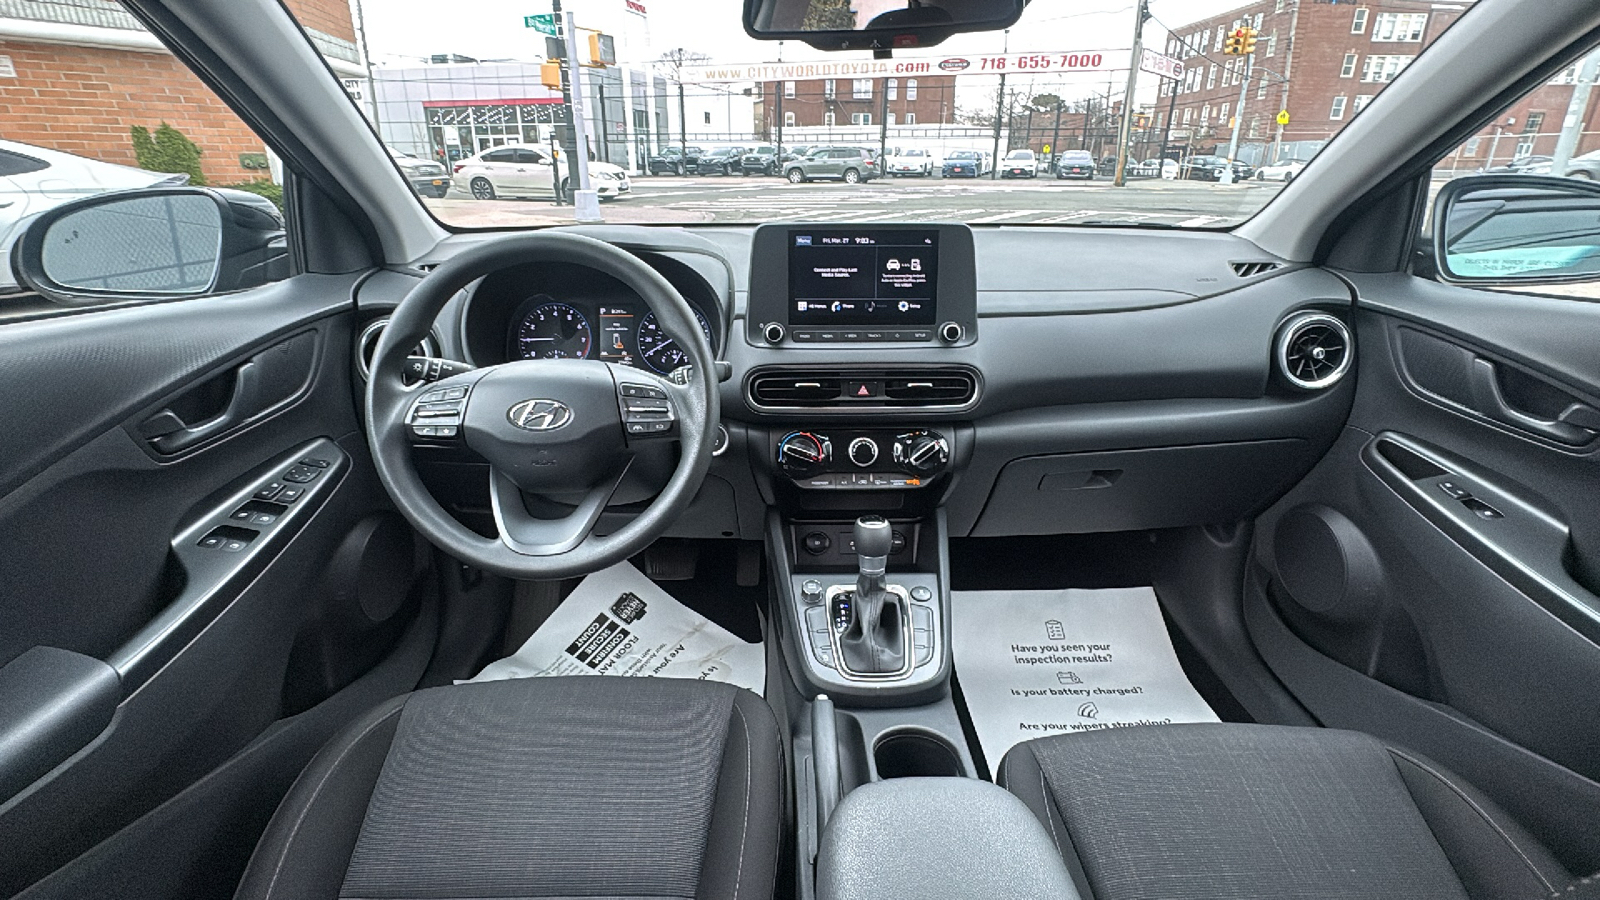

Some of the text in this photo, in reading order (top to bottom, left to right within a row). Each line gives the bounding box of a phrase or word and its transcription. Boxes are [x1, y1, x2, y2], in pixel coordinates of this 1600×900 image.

[574, 622, 600, 648] COUNT
[584, 628, 612, 656] SECURE
[592, 633, 624, 664] CONFIRM
[613, 634, 640, 660] FLOOR
[669, 644, 686, 659] Are
[1011, 644, 1111, 654] Have you seen your
[652, 656, 673, 675] your
[1014, 653, 1113, 666] inspection results?
[1010, 686, 1144, 698] Is your battery charged?
[1019, 722, 1041, 731] Are
[1042, 722, 1068, 731] your
[1069, 721, 1110, 732] wipers
